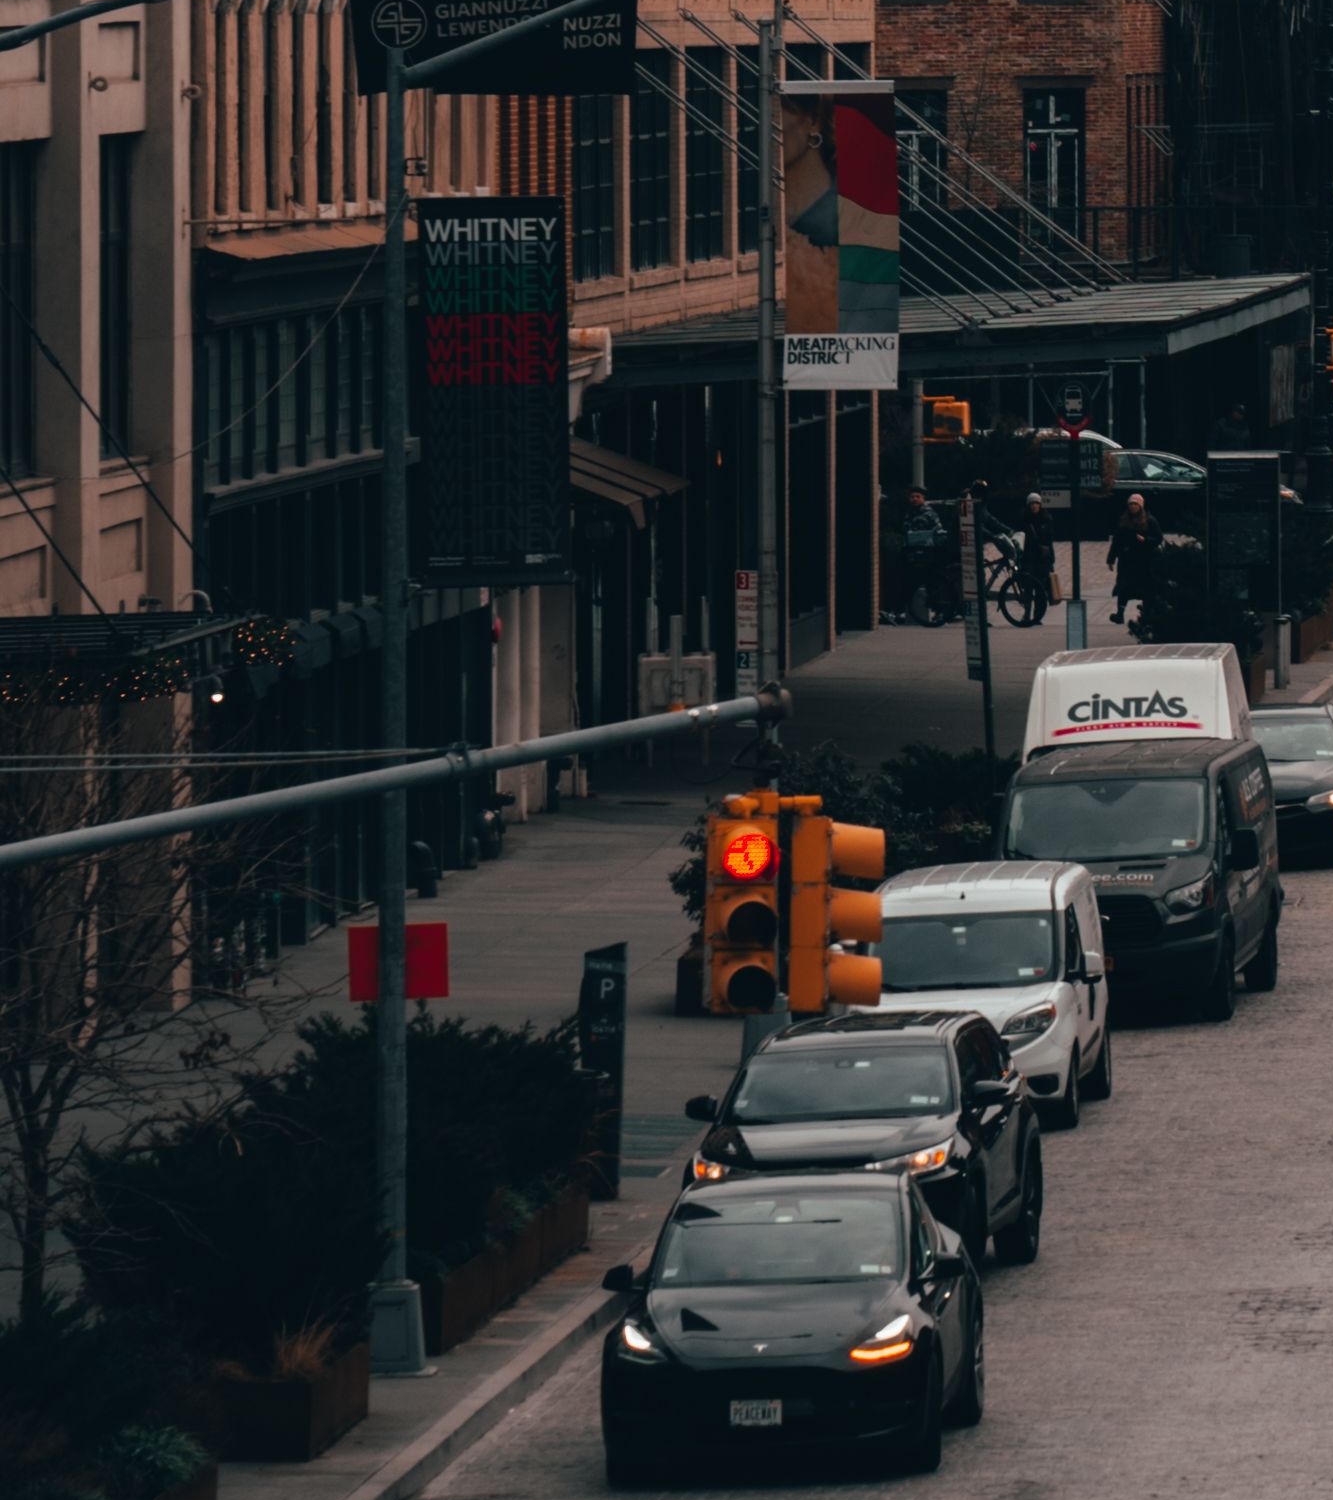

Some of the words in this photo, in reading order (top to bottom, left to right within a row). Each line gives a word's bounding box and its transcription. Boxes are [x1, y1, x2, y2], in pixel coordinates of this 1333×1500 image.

[563, 13, 621, 31] NUZZI
[563, 32, 622, 49] NDON
[424, 217, 558, 242] WHITNEY
[425, 241, 558, 266] WHITNEY
[425, 265, 559, 290] WHITNEY
[425, 289, 559, 314] WHITNEY
[425, 312, 561, 338] WHITNEY
[426, 336, 560, 362] WHITNEY
[788, 336, 896, 351] MEATPACKING
[787, 351, 850, 365] DISTRICT
[427, 360, 561, 386] WHITNEY
[739, 653, 748, 668] 2
[600, 977, 615, 1000] P
